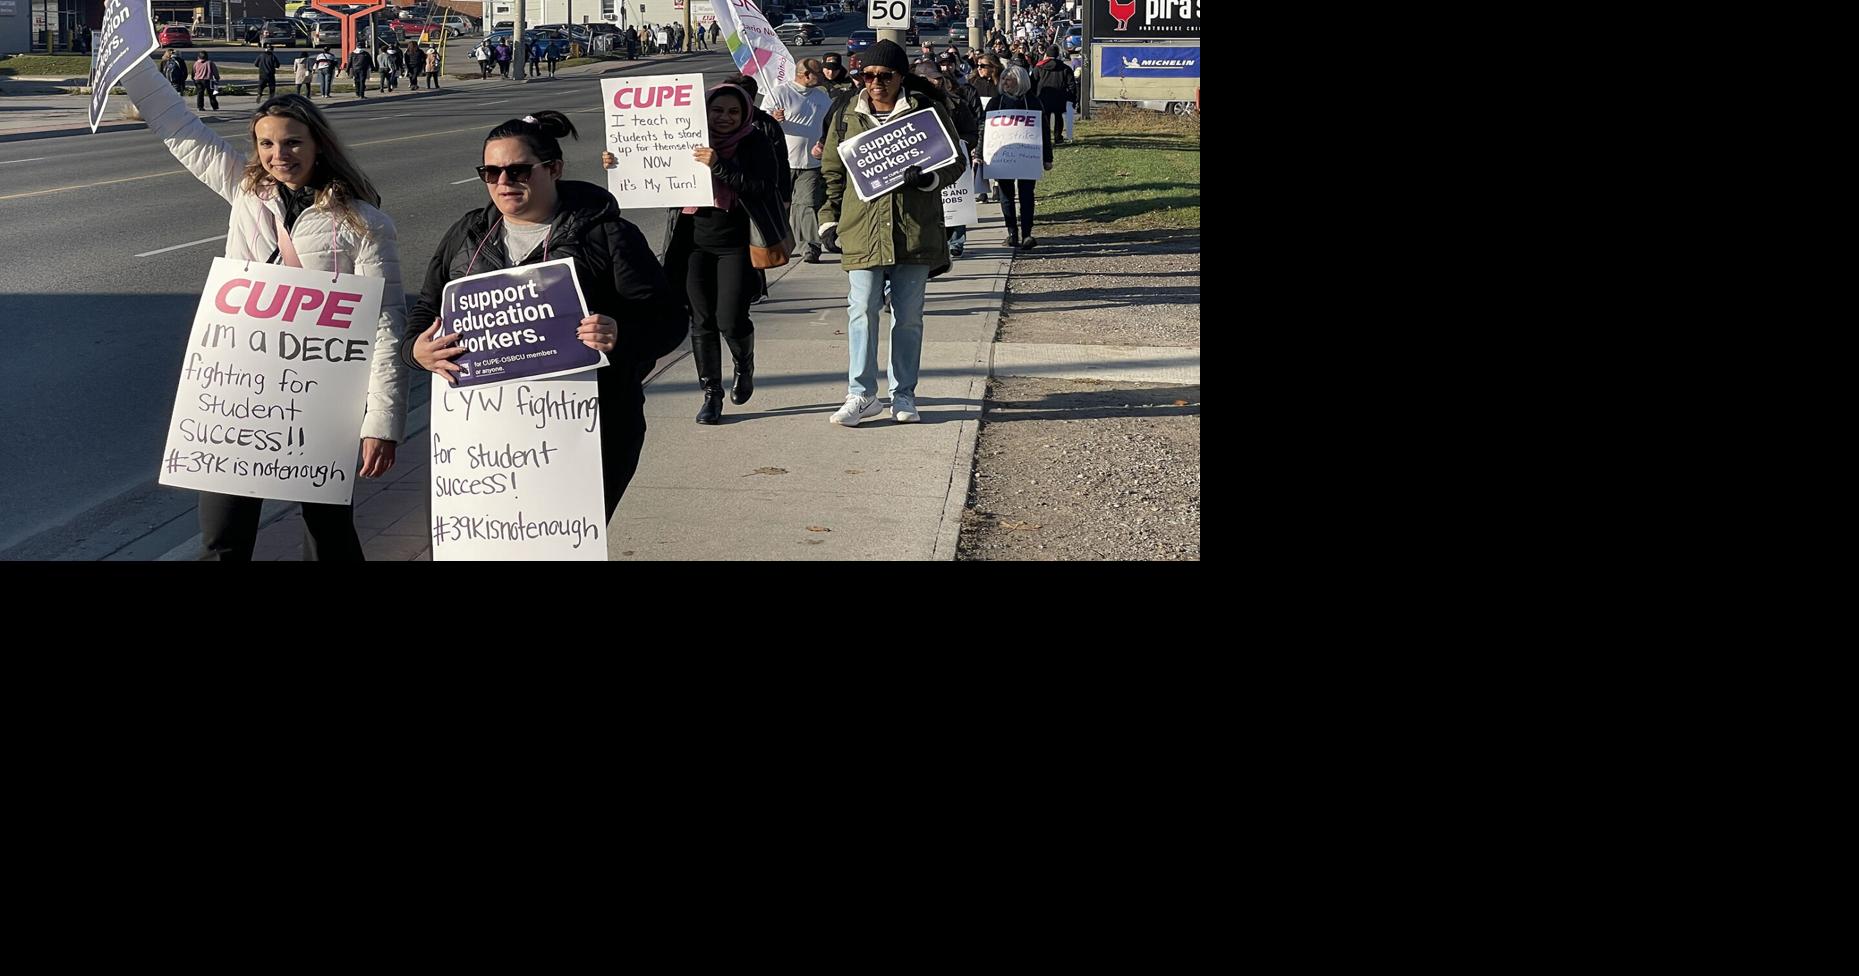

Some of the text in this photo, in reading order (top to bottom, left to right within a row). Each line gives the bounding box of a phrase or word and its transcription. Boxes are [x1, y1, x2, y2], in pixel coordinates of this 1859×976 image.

[872, 0, 906, 20] 50
[614, 84, 693, 110] CUPE
[611, 114, 691, 130] I teach my
[990, 114, 1036, 126] CUPE
[664, 130, 674, 140] to
[678, 130, 702, 139] stand
[850, 122, 916, 158] I support
[618, 147, 632, 156] up
[636, 144, 648, 152] for
[643, 156, 672, 168] NOW
[856, 131, 928, 168] education
[862, 148, 924, 178] workers.
[644, 178, 660, 192] My
[666, 174, 697, 190] Turn!
[950, 188, 968, 196] AND
[214, 278, 363, 329] CUPE
[451, 280, 539, 312] I support
[452, 302, 555, 334] education
[250, 330, 266, 354] a
[278, 331, 369, 362] DECE
[457, 326, 546, 354] workers.
[482, 354, 526, 367] CUPE-OSBCU
[526, 349, 558, 359] members
[482, 366, 505, 375] anyone.
[185, 352, 318, 395] fighting for
[516, 385, 599, 432] fighting
[433, 432, 456, 465] for
